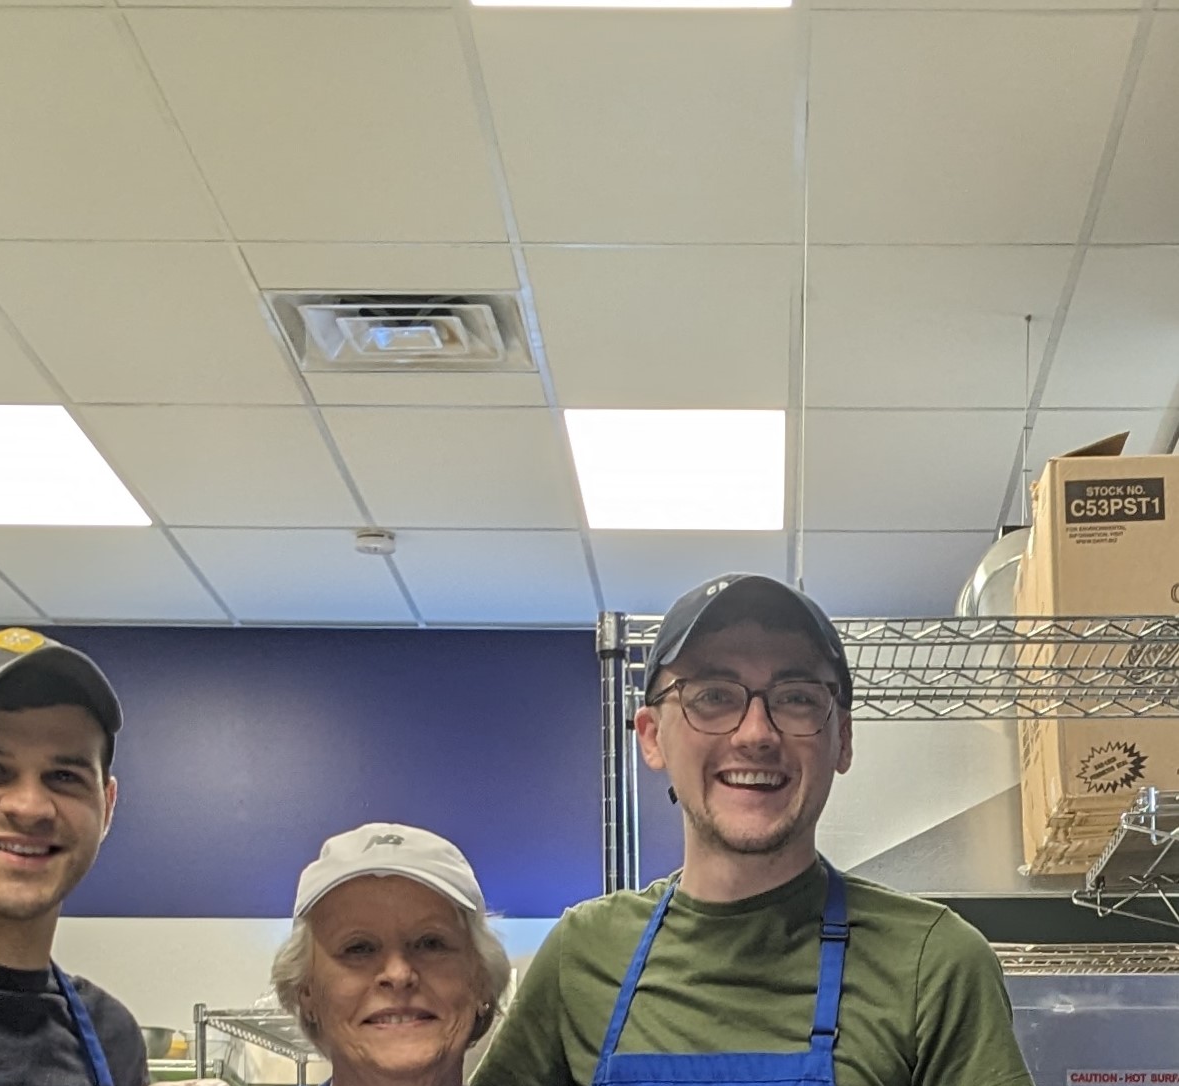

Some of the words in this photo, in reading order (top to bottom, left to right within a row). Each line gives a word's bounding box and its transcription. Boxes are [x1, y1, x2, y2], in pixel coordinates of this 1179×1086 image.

[1086, 486, 1124, 497] STOCK
[1127, 485, 1145, 495] NO.
[1070, 497, 1160, 517] C53PST1
